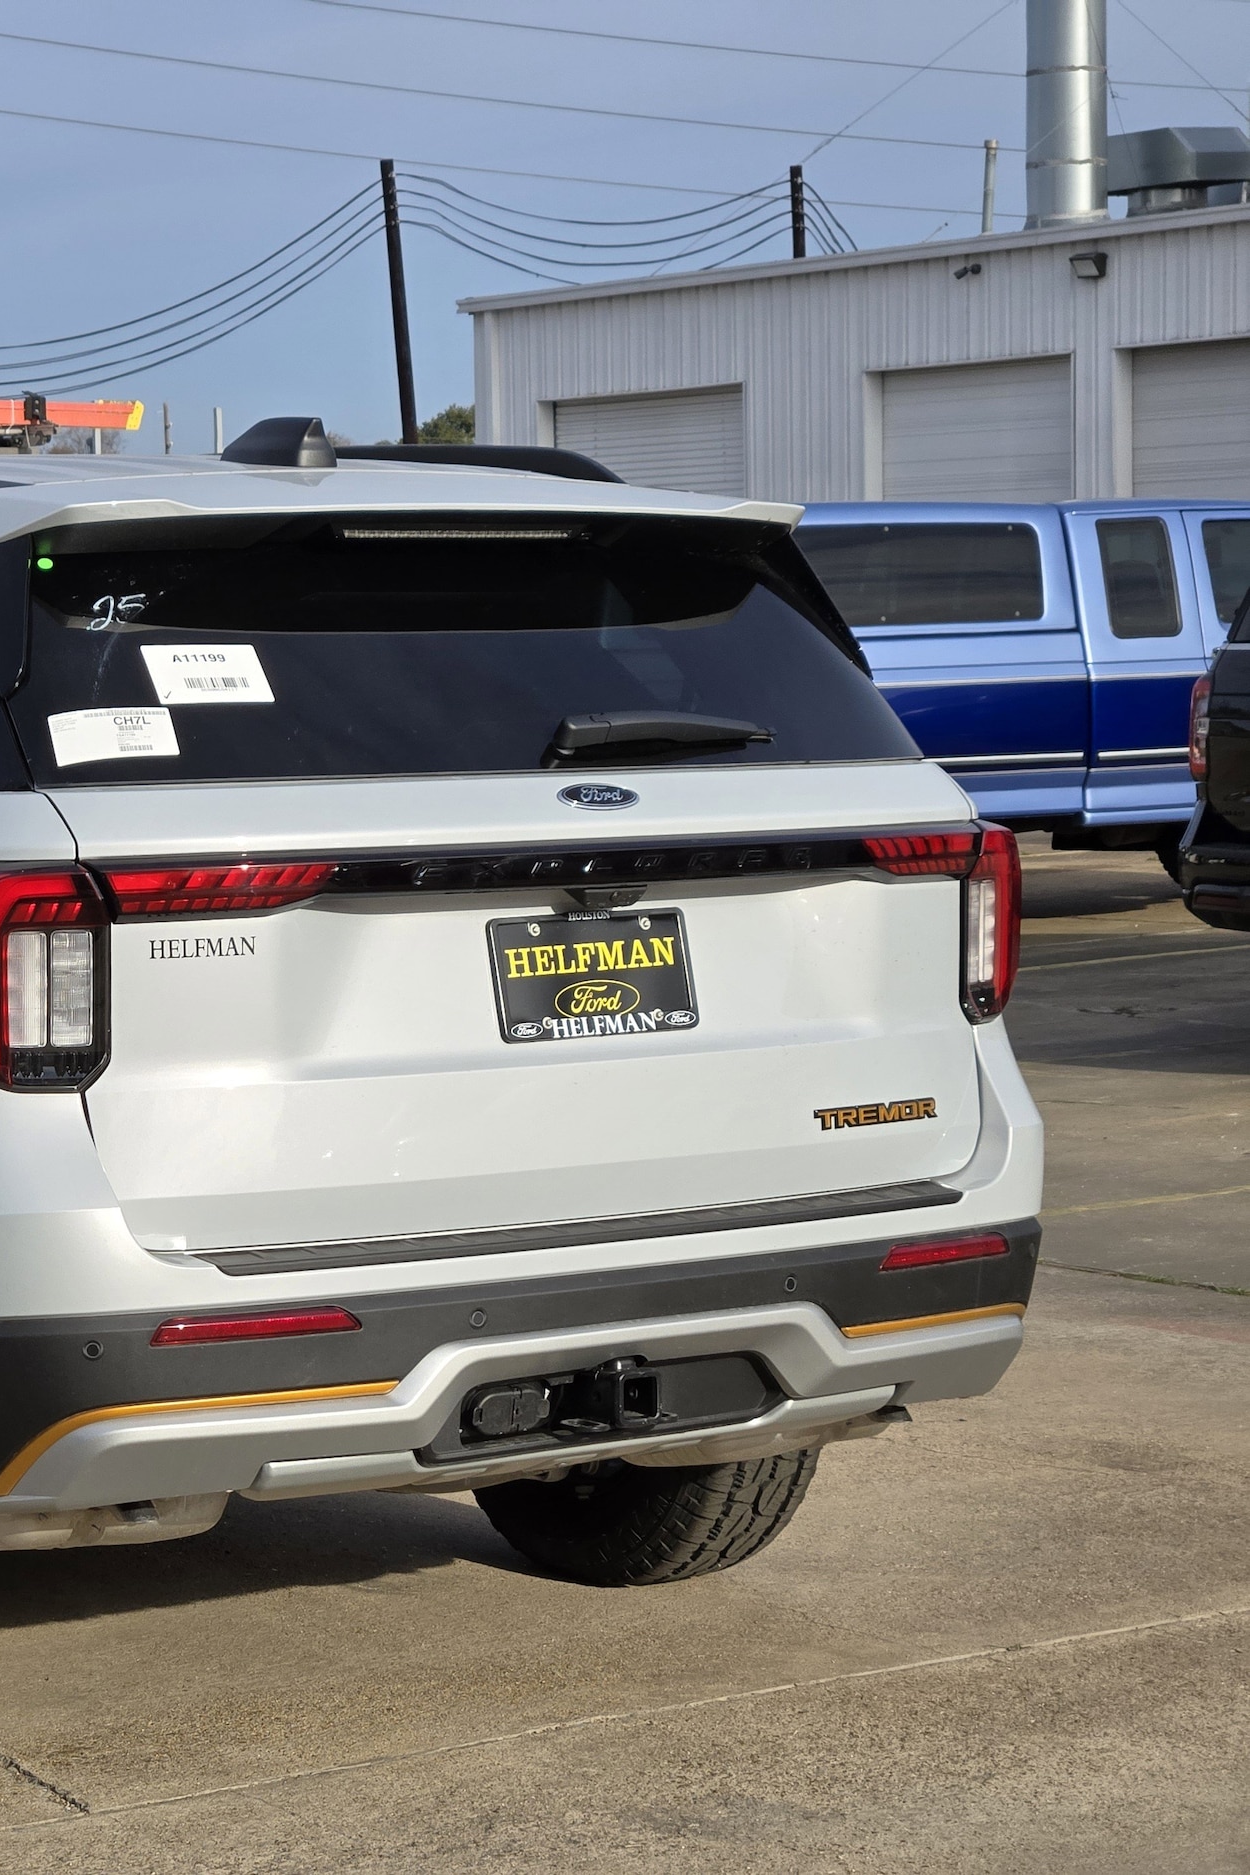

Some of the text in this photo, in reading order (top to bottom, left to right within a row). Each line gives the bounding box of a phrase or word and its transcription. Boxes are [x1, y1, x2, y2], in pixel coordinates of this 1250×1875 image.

[87, 593, 147, 631] 25
[172, 653, 226, 663] A11199
[113, 716, 152, 726] CH7L
[580, 786, 623, 802] Ford
[414, 849, 813, 884] EXPLORER
[567, 910, 611, 921] HOUSTON
[148, 935, 256, 959] HELFMAN
[504, 936, 675, 978] HELFMAN
[570, 985, 622, 1015] Ford
[551, 1011, 656, 1039] HELFMAN
[813, 1097, 938, 1131] TREMOR
